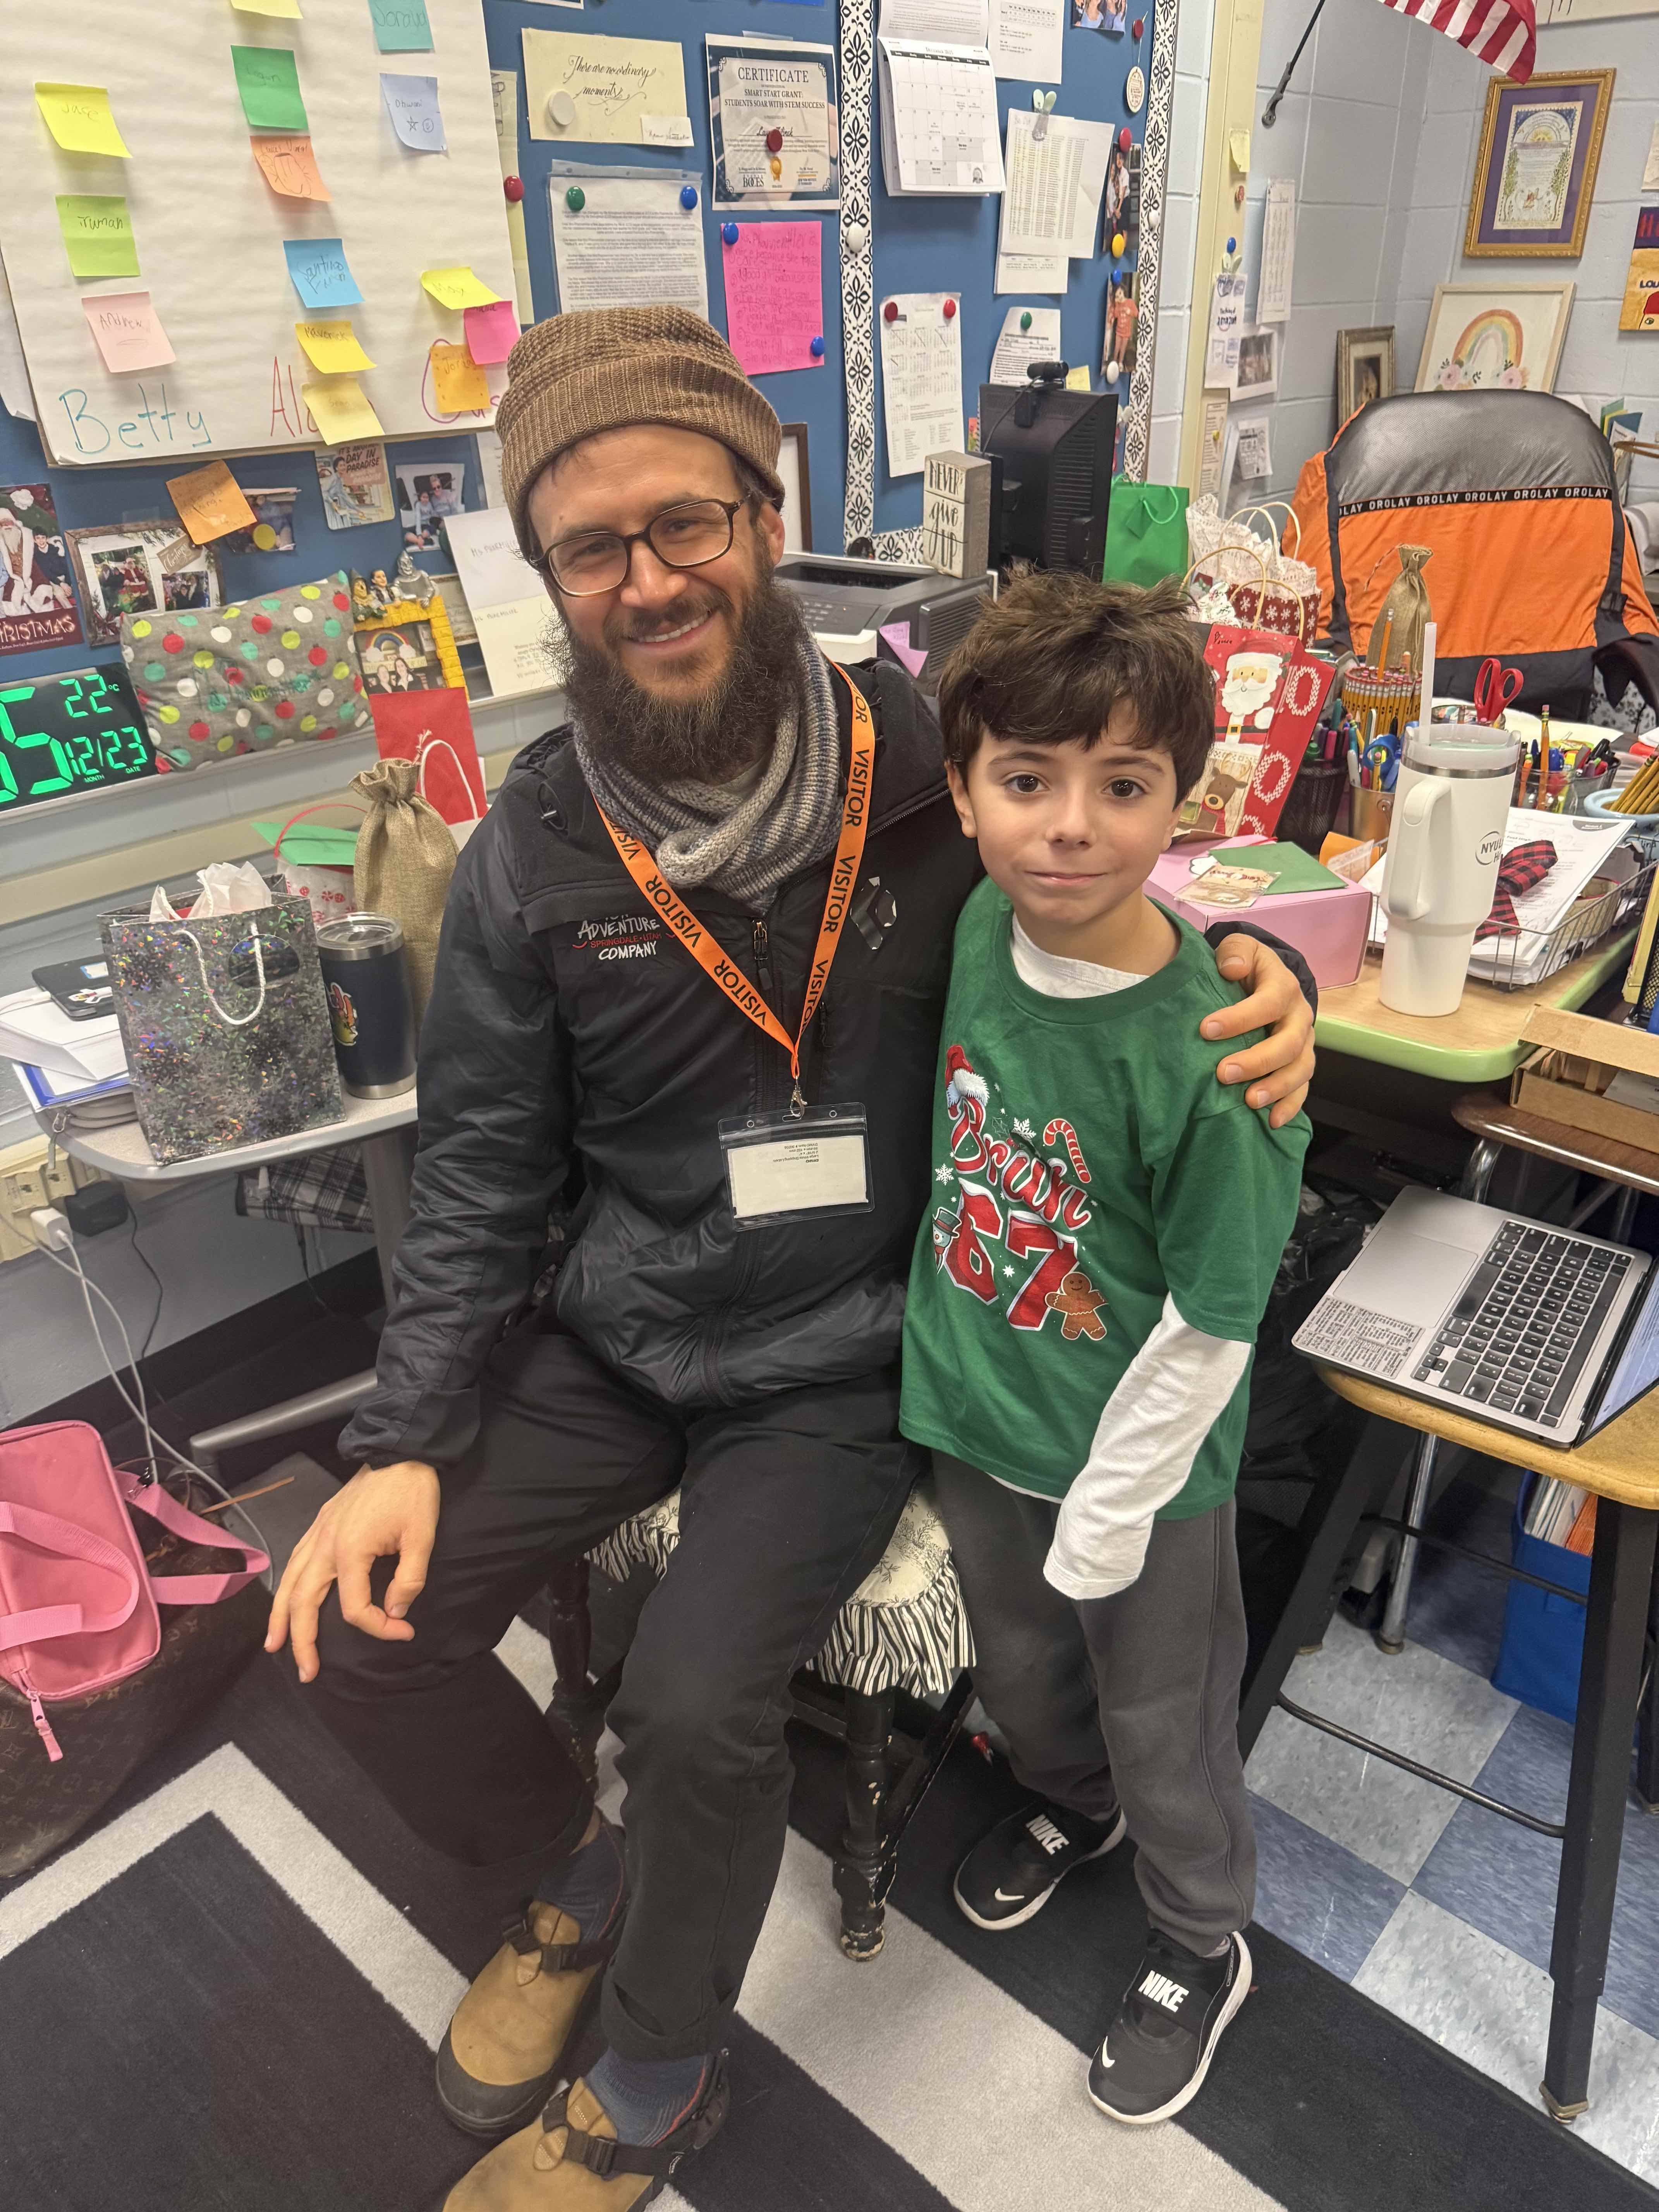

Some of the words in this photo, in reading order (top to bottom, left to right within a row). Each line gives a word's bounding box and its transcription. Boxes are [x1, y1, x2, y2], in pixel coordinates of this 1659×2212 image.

[738, 67, 809, 82] CERTIFICATE
[744, 89, 763, 97] SMART
[725, 99, 753, 107] STUDENTS
[59, 383, 212, 455] Betty
[346, 451, 363, 464] DAY
[366, 448, 376, 459] IN
[346, 457, 380, 473] PARADISE
[930, 459, 961, 496] NEVER
[1369, 497, 1411, 510] OROLAY
[1417, 493, 1459, 506] OROLAY
[1465, 491, 1508, 502] OROLAY
[1513, 488, 1558, 500] OROLAY
[1565, 486, 1608, 498] OROLAY
[929, 499, 958, 560] give
[940, 532, 958, 570] UP
[84, 774, 105, 783] MONTH
[125, 765, 141, 774] DATE
[845, 748, 870, 828] VISITOR
[607, 814, 643, 862] VISIT
[645, 874, 702, 948] VISITOR
[823, 855, 856, 934] VISITOR
[577, 917, 660, 940] ADVENTURE
[598, 940, 657, 960] COMPANY
[713, 959, 766, 1026] VISITOR
[945, 1177, 1080, 1331] 67
[1025, 1814, 1070, 1856] NIKE
[1137, 1970, 1190, 2013] NIKE
